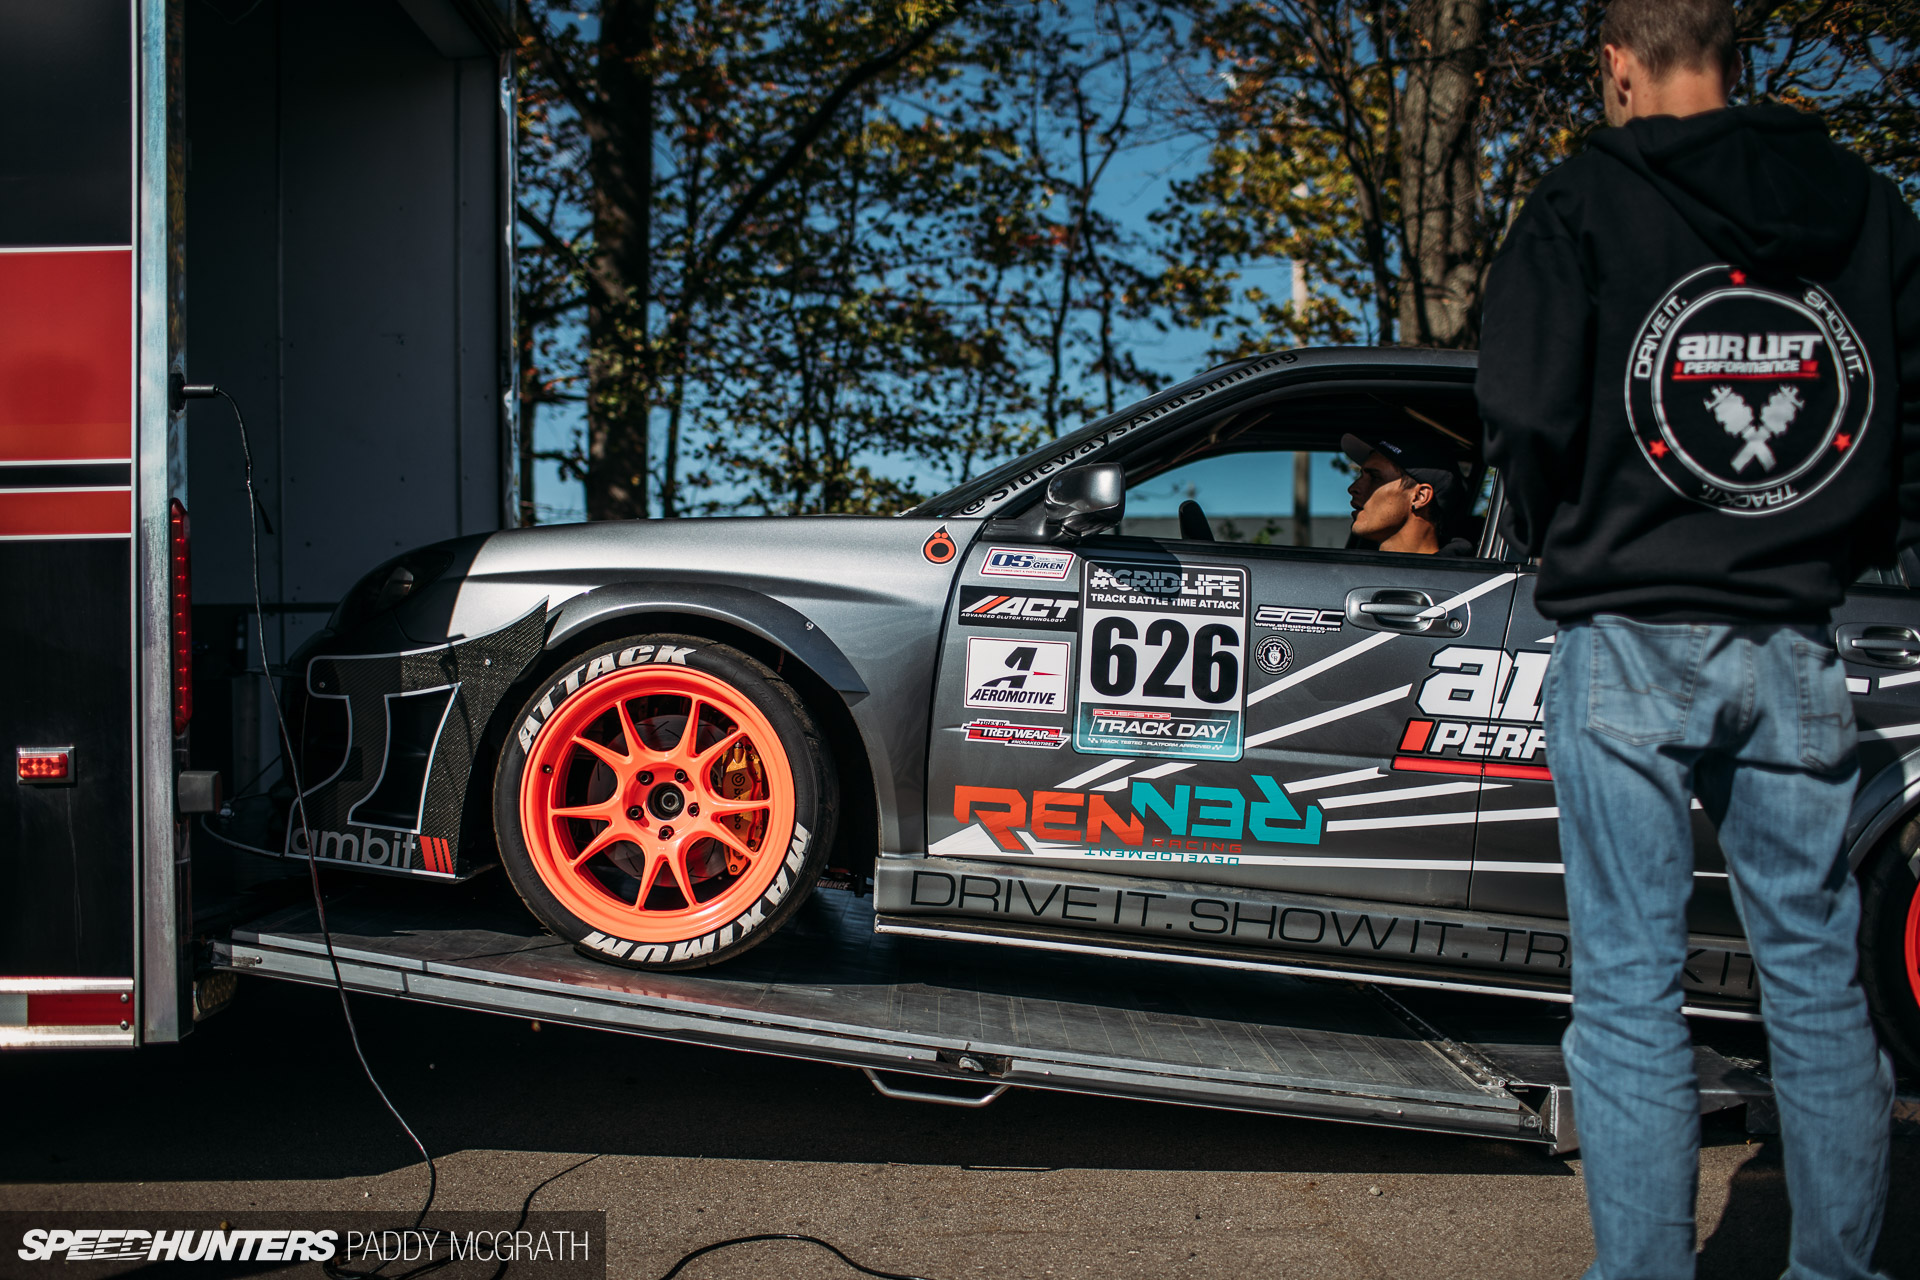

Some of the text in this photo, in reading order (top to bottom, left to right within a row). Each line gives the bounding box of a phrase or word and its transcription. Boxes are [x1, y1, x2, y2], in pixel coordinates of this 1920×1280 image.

[991, 553, 1034, 568] OS
[1033, 562, 1064, 570] GIKEN
[1091, 593, 1240, 610] TRACK BATTLE TIME ATTACK
[1090, 616, 1240, 704] 626
[517, 644, 697, 755] ATTACK
[969, 689, 1056, 705] AEROMOTIVE
[1094, 710, 1171, 720] POWERSTOP
[1097, 719, 1226, 739] TRACK DAY
[290, 827, 416, 869] ambit
[1152, 838, 1242, 853] RACING
[1084, 847, 1240, 866] DEVELOPMENT
[579, 821, 812, 963] MAXIMUM
[910, 870, 1100, 922] DRIVE
[1112, 890, 1172, 930] IT.
[1188, 897, 1398, 950] SHOW
[1410, 919, 1468, 959] IT.
